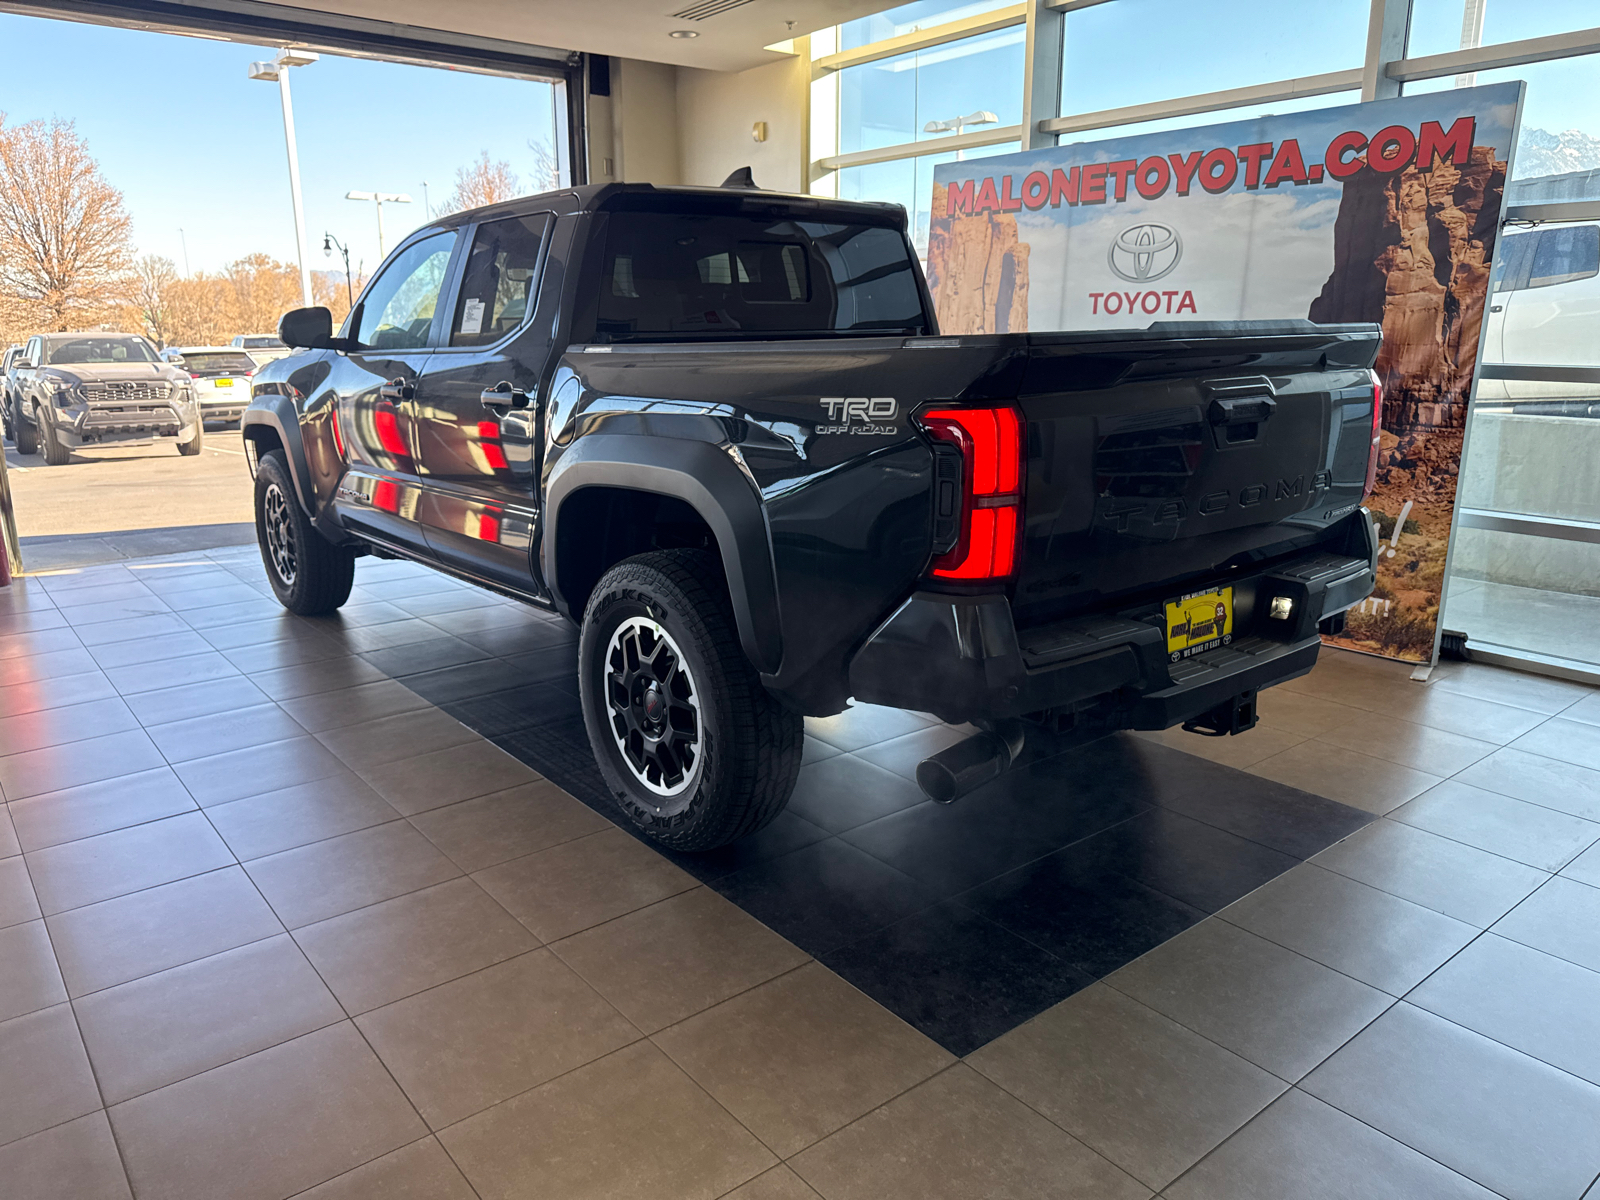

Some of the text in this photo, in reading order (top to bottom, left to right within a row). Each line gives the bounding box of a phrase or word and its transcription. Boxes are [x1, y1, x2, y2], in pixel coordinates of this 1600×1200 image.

[946, 116, 1476, 217] MALONETOYOTA.COM
[1088, 290, 1197, 315] TOYOTA
[819, 397, 899, 426] TRD
[815, 424, 898, 435] OFF ROAD
[1103, 468, 1333, 533] TACOMA
[592, 588, 669, 624] FALKEN
[1216, 606, 1224, 617] 32
[1183, 639, 1221, 658] WE MAKE IT EASY
